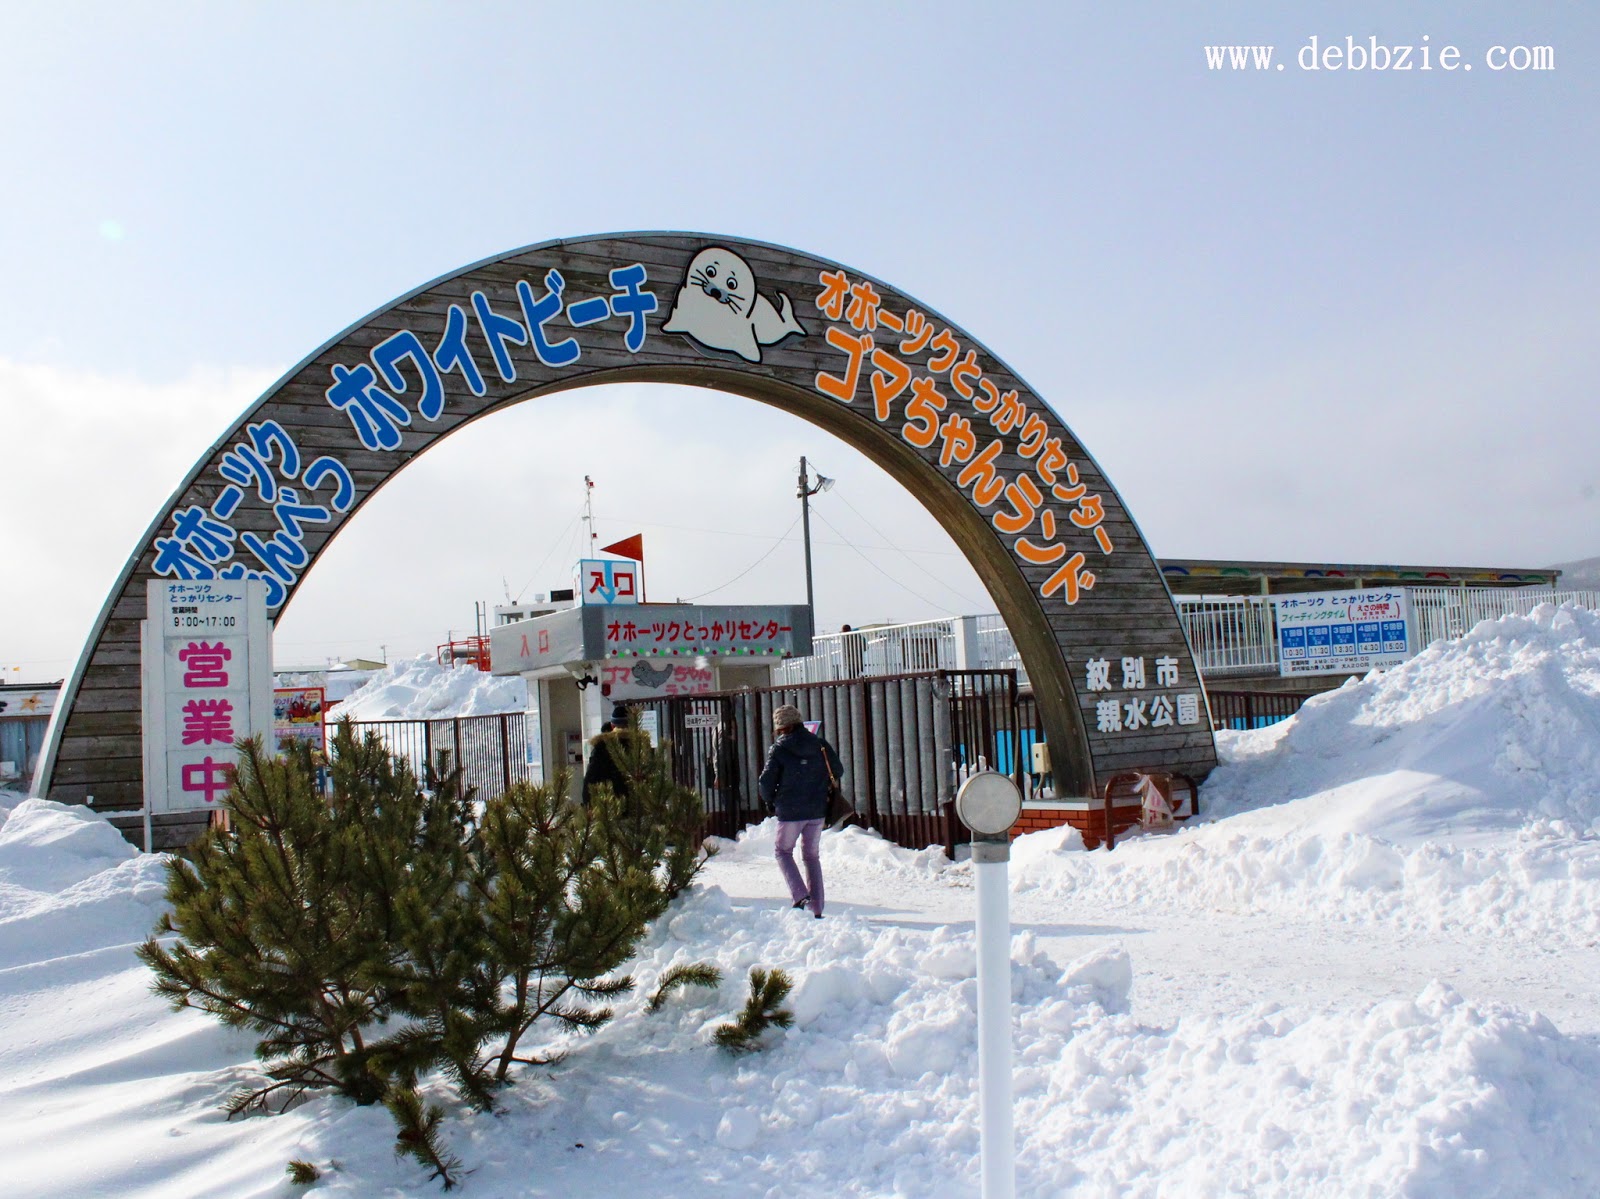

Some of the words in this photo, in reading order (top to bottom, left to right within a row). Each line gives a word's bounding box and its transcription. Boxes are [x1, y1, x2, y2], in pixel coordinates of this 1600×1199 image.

[325, 263, 658, 451] ホワイトビーチ
[815, 270, 1113, 555] オホーツクとっかりセンター
[815, 326, 1095, 605] ゴマちゃんランド
[152, 419, 300, 580] オホーツク
[168, 585, 212, 593] オホーツク
[170, 594, 242, 603] とっかりセンター
[589, 571, 634, 596] 入口
[1281, 597, 1325, 609] オホーツク
[1331, 593, 1402, 606] とっかりセンター
[520, 629, 549, 657] 入口
[607, 620, 792, 642] オホーツクとっかりセンター
[1086, 656, 1180, 691] 紋別市
[178, 641, 236, 803] 営業中
[1096, 694, 1200, 732] 親水公園
